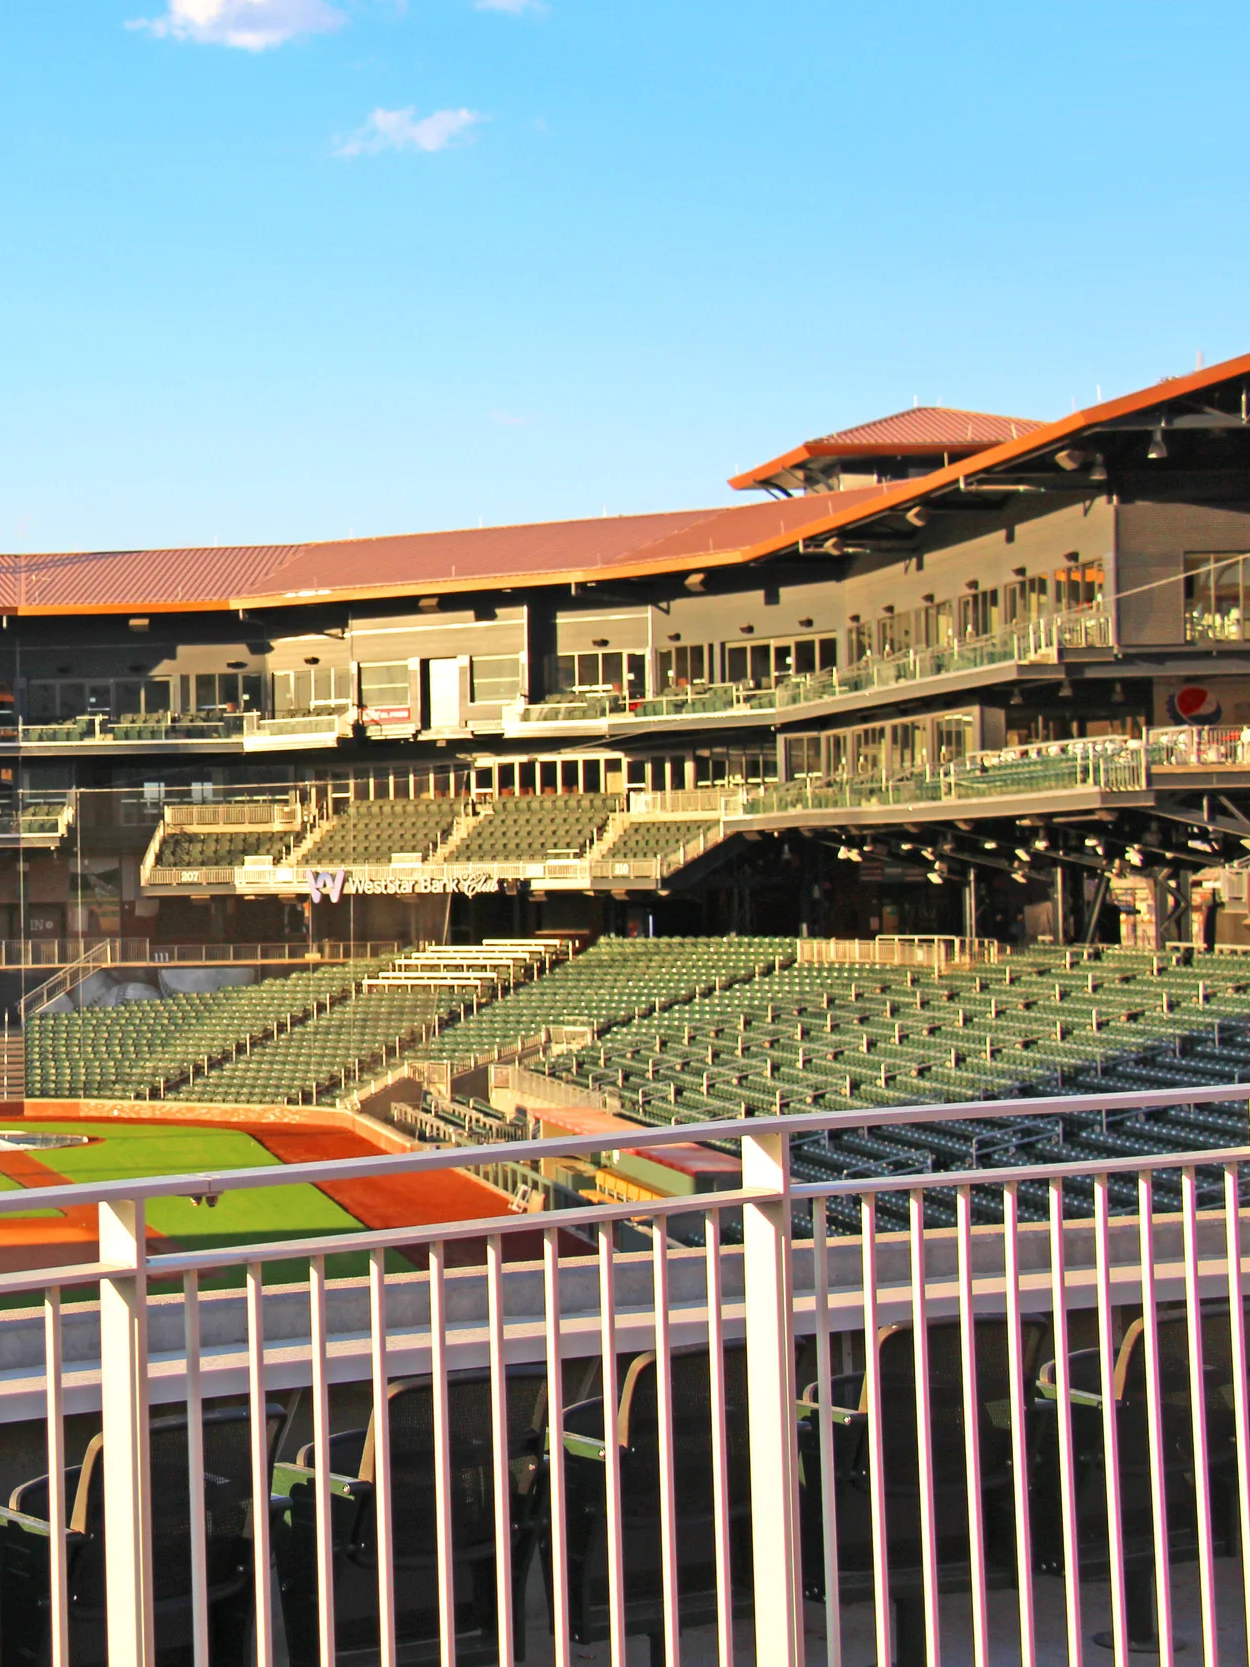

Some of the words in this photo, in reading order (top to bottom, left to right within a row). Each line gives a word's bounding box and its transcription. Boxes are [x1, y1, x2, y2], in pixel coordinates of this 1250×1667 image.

[181, 870, 199, 882] 207
[349, 878, 415, 895] WestStar
[420, 876, 458, 894] Bank
[154, 952, 169, 963] 111
